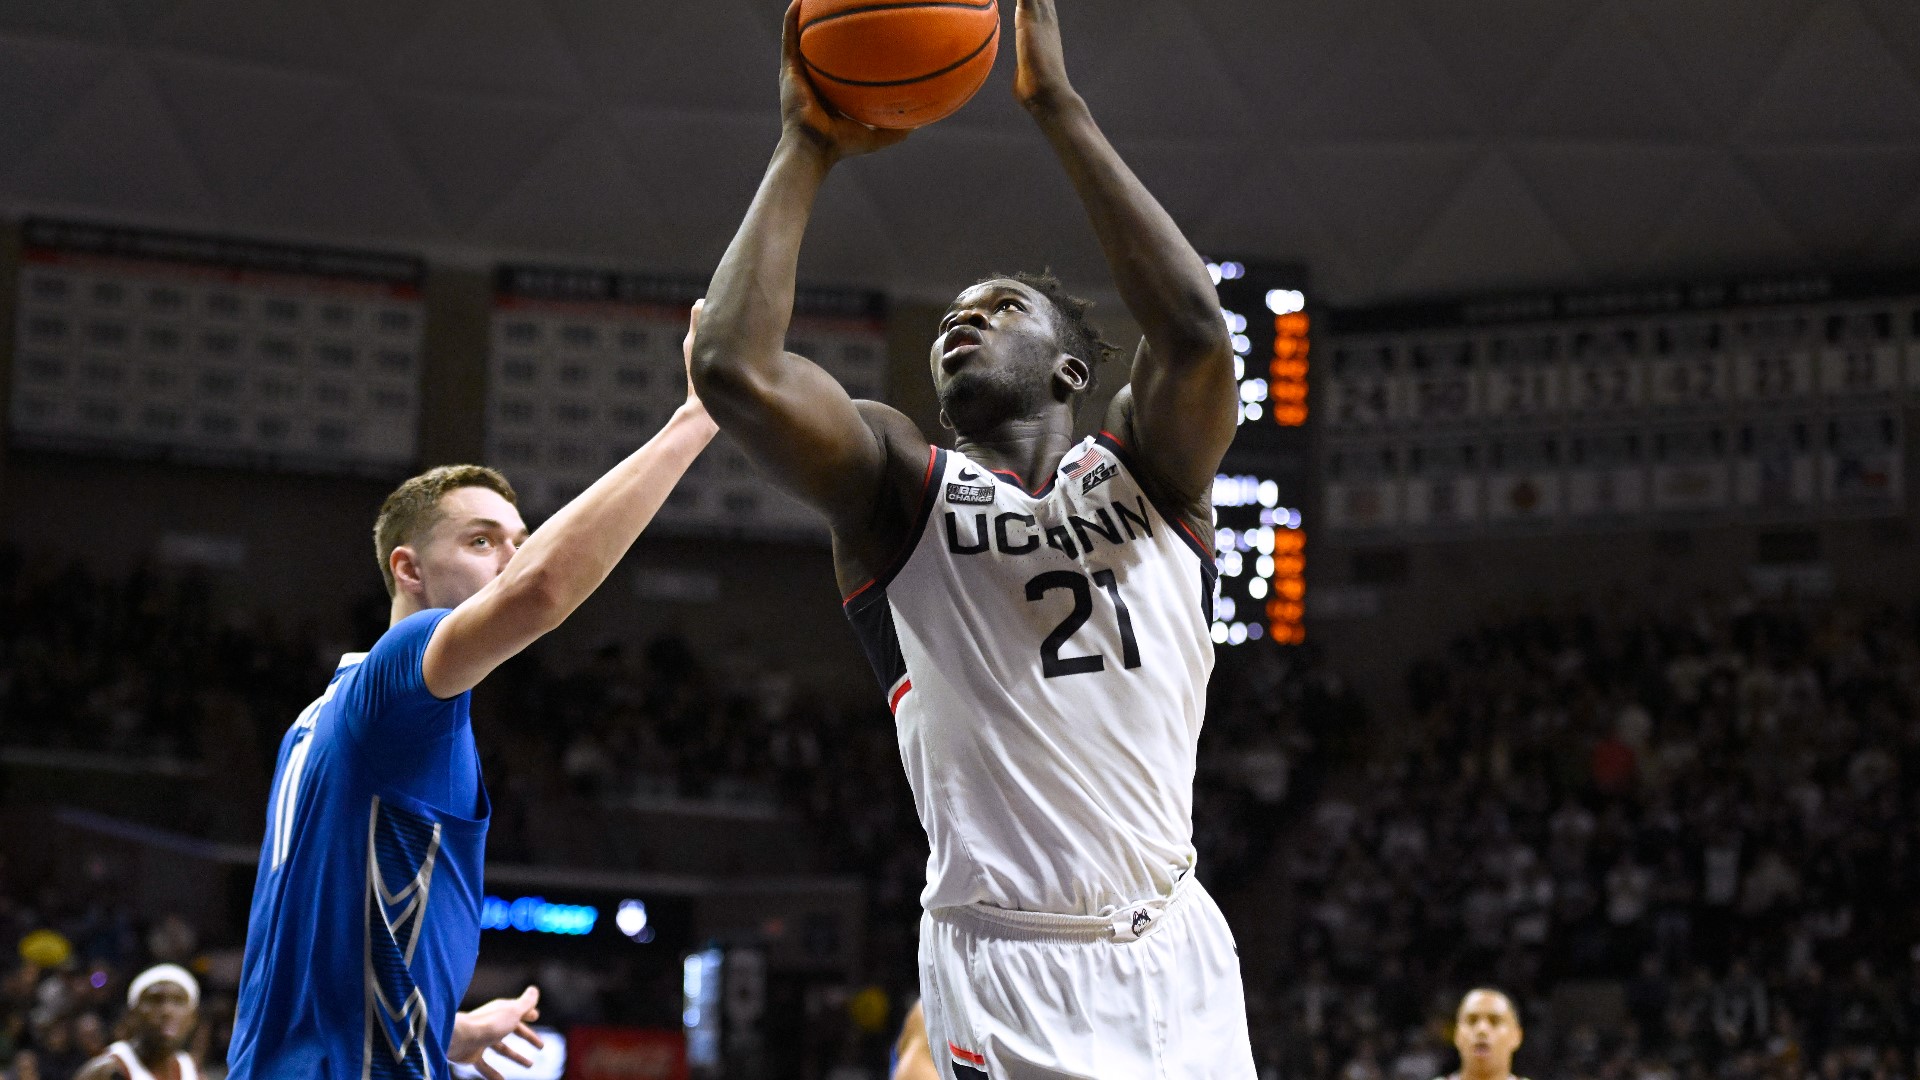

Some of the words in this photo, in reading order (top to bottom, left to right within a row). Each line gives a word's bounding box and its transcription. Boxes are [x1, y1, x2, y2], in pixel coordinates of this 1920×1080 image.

[1082, 462, 1106, 483] BIG
[1082, 463, 1118, 494] EAST
[948, 493, 993, 502] CHANGE
[958, 486, 980, 496] BE
[1025, 568, 1141, 679] 21
